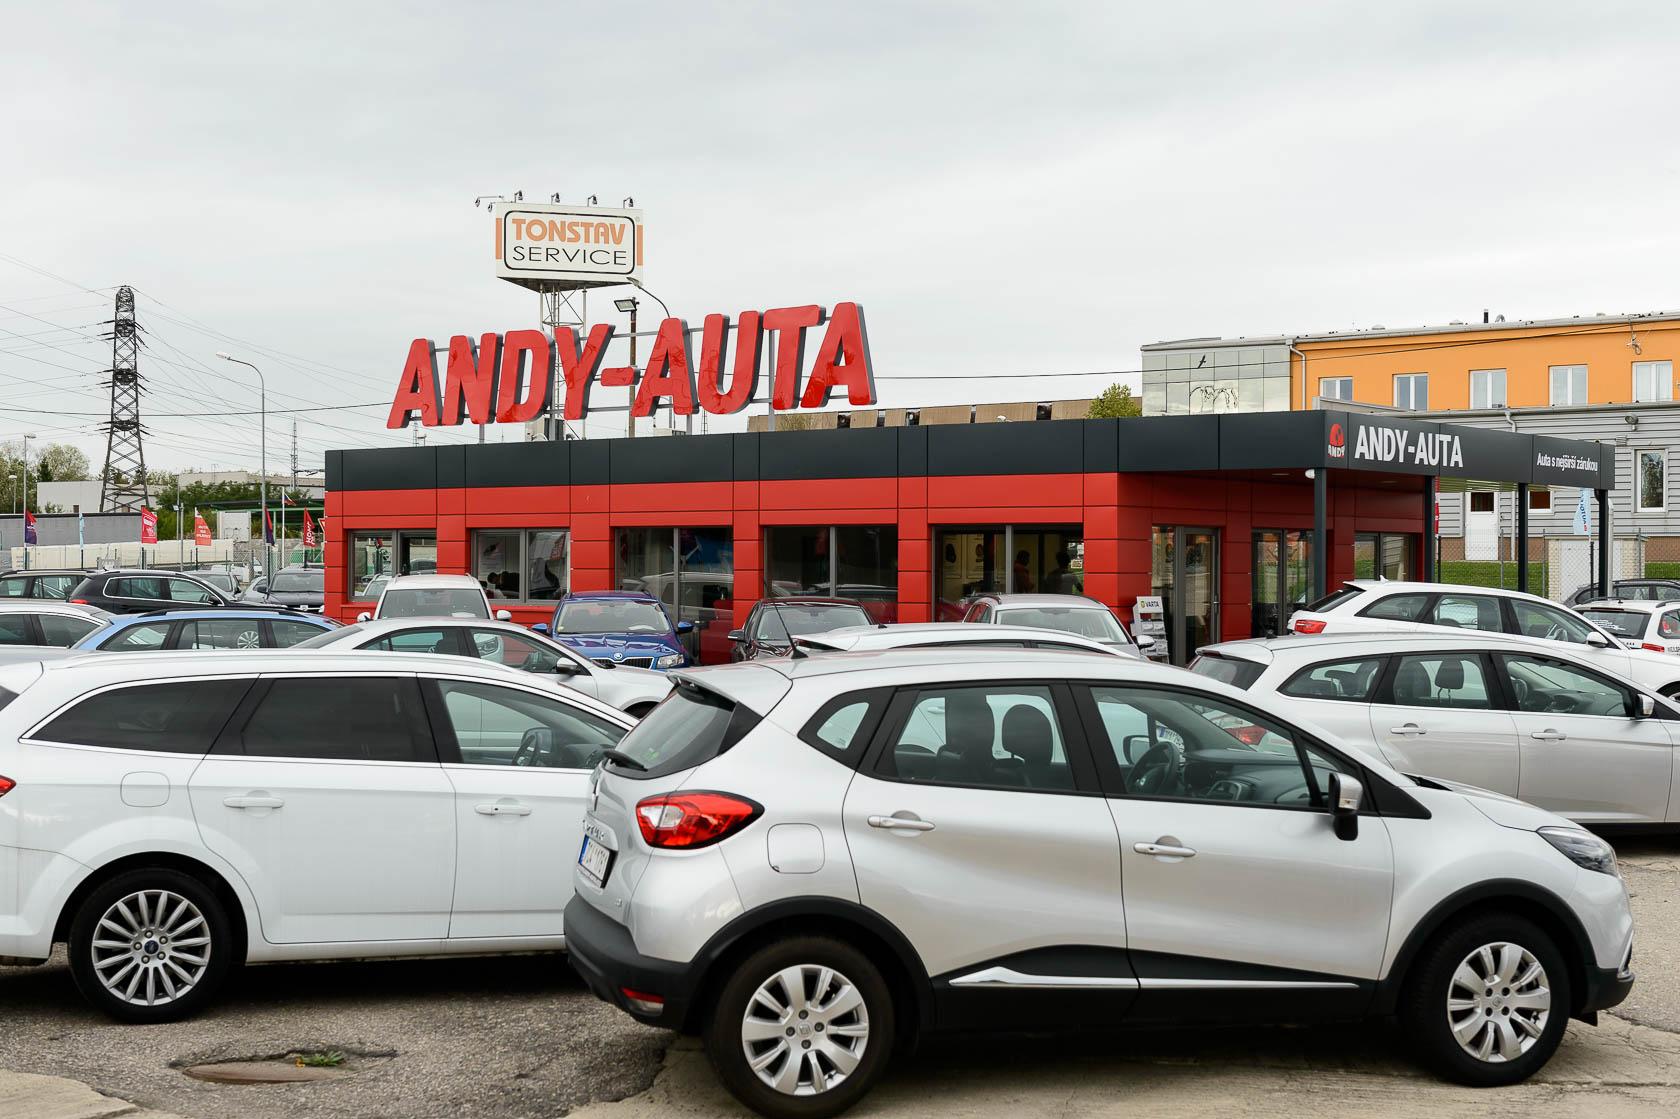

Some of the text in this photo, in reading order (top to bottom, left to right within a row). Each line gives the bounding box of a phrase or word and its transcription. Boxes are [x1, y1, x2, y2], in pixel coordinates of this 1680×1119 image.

[512, 218, 626, 245] TONSTAV
[512, 246, 627, 265] SERVICE
[386, 302, 878, 429] ANDY-AUTA
[1328, 444, 1345, 458] ANDY
[1354, 425, 1464, 468] ANDY-AUTA
[1536, 452, 1551, 467] Auta
[1551, 456, 1556, 467] s
[1577, 456, 1598, 471] zárukou
